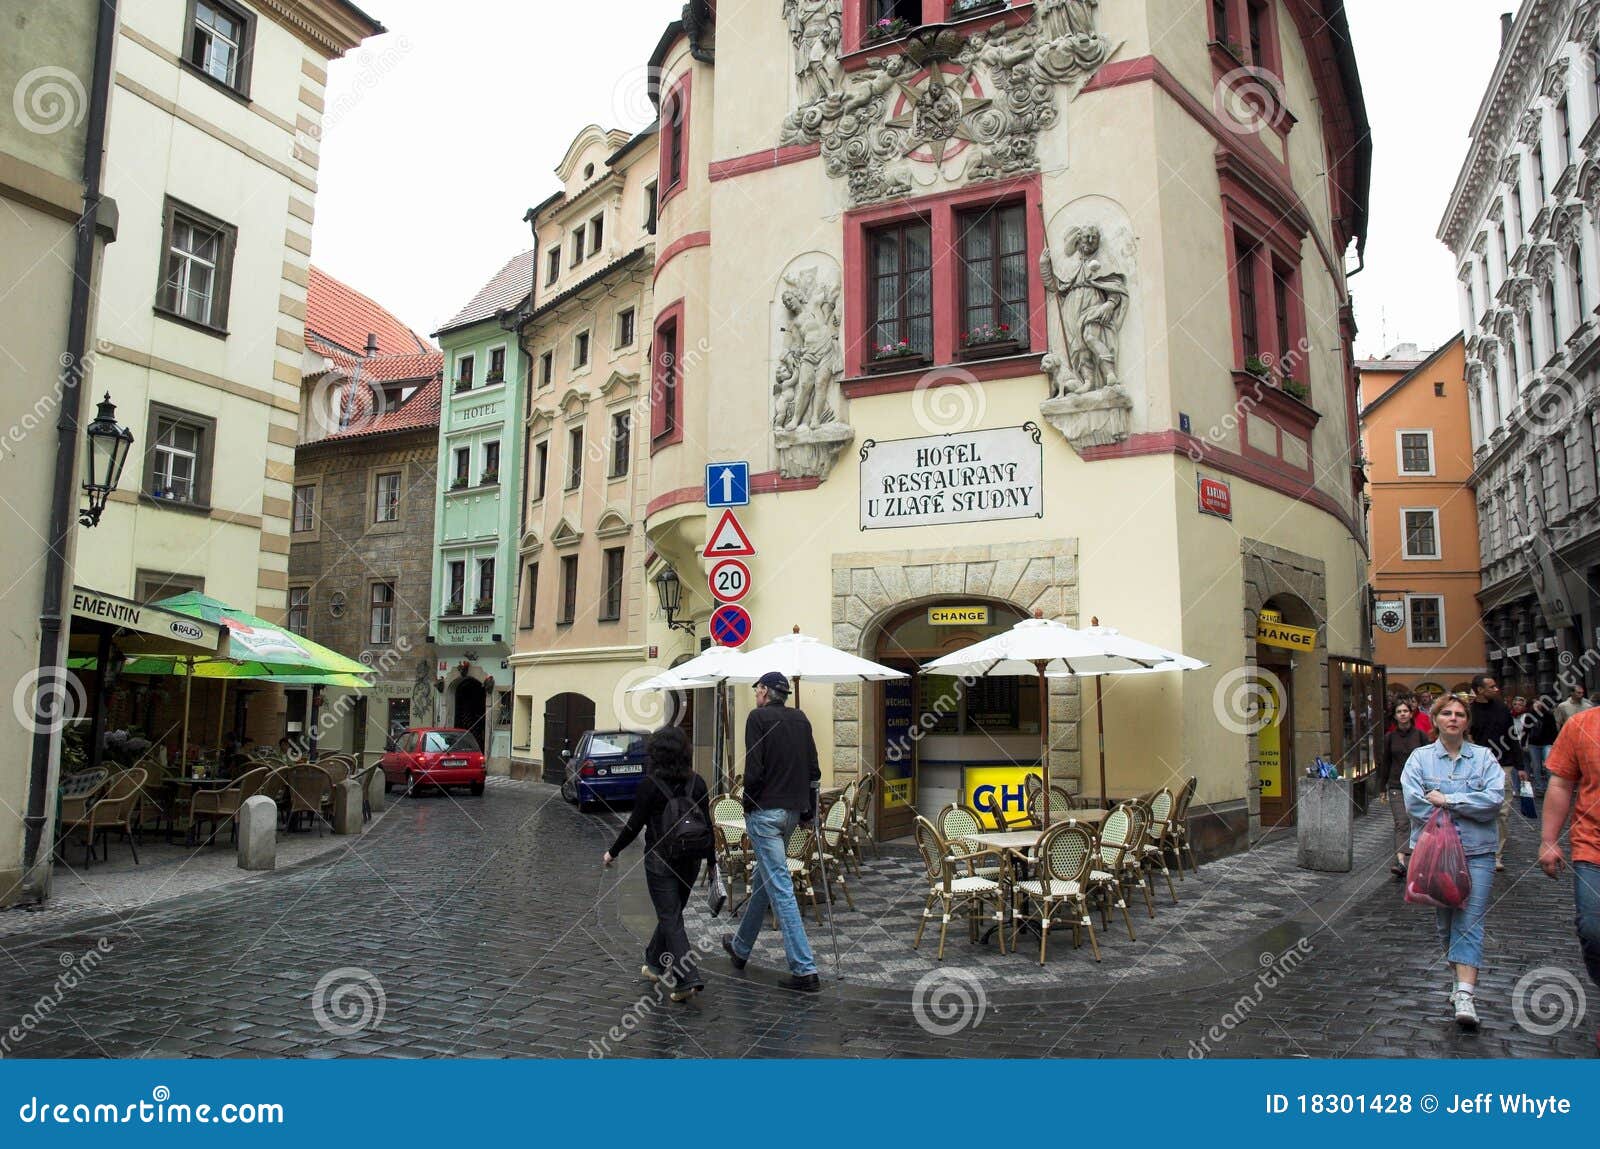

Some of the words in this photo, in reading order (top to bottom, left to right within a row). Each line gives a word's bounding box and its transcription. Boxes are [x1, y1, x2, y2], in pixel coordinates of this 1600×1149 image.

[463, 403, 497, 420] HOTEL
[916, 442, 981, 468] HOTEL
[882, 462, 1018, 494] RESTAURANT
[868, 499, 880, 518] U
[884, 490, 945, 517] ZLATÉ
[952, 486, 1033, 512] STUDNY
[718, 571, 741, 590] 20
[73, 594, 140, 624] EMENTIN
[931, 612, 985, 621] CHANGE
[178, 624, 200, 637] RAUCH
[446, 624, 489, 634] Clementin
[1257, 627, 1311, 645] HANGE
